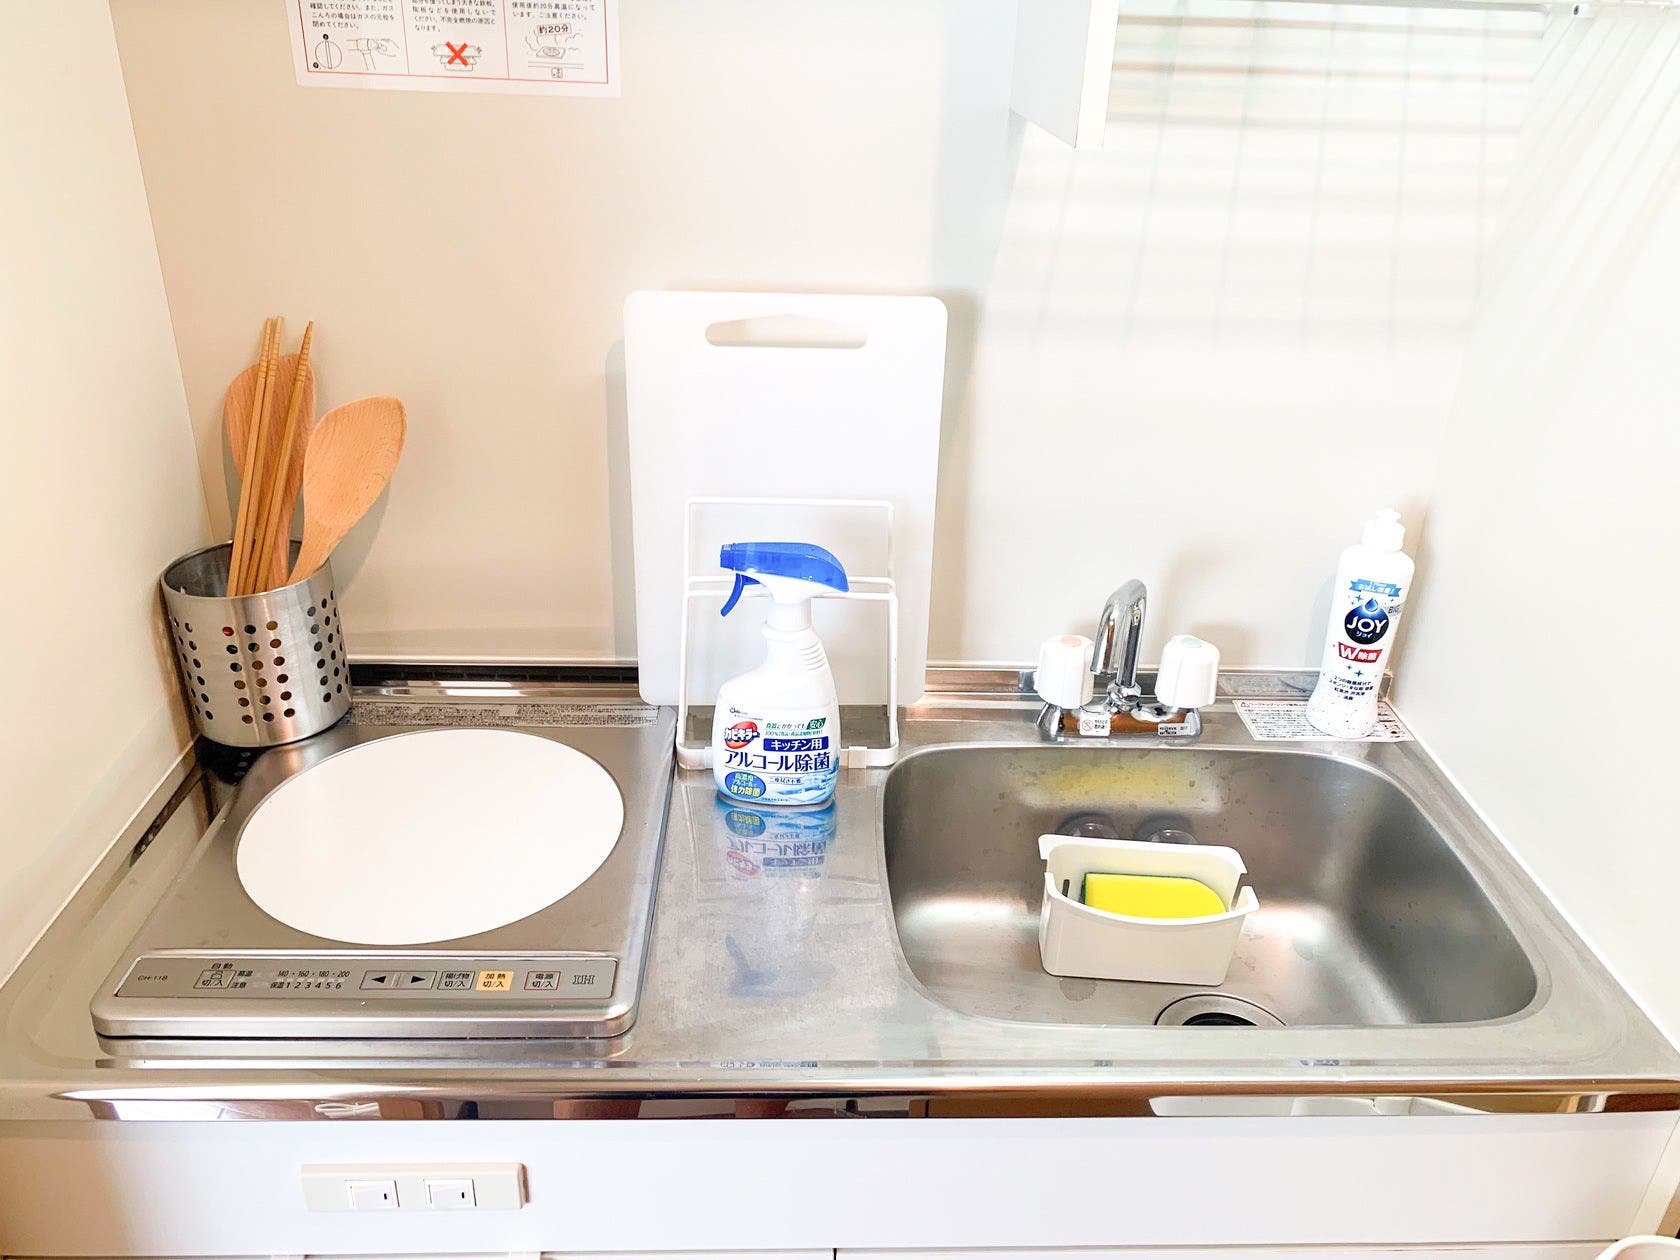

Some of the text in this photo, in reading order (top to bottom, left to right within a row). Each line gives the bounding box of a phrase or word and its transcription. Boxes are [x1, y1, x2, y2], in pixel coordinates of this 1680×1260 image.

[539, 24, 569, 34] 約20分
[1346, 616, 1387, 633] JOY
[724, 728, 760, 742] カビキラー
[770, 739, 823, 751] キッチン用
[725, 750, 830, 772] アルコール除菌
